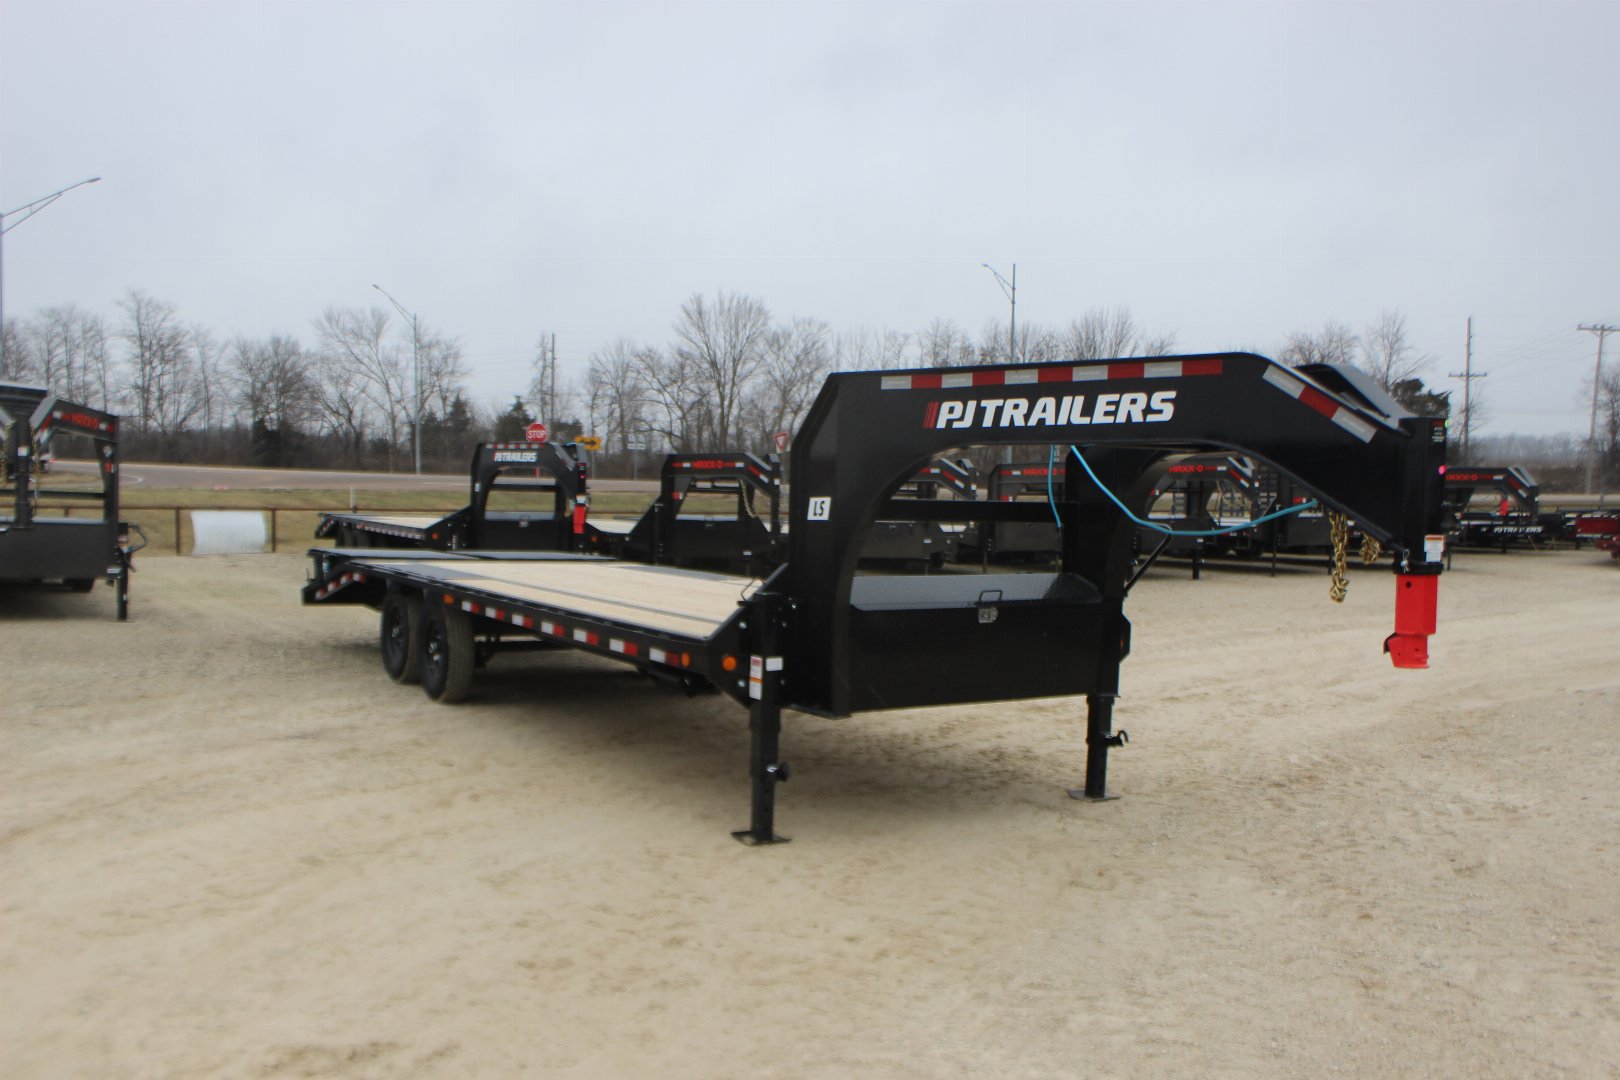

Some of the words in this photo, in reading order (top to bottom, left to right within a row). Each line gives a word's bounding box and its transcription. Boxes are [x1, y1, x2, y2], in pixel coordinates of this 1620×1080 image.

[936, 401, 976, 429] PJ
[980, 391, 1177, 428] TRAILERS
[527, 430, 546, 439] STOP
[813, 500, 825, 517] LS
